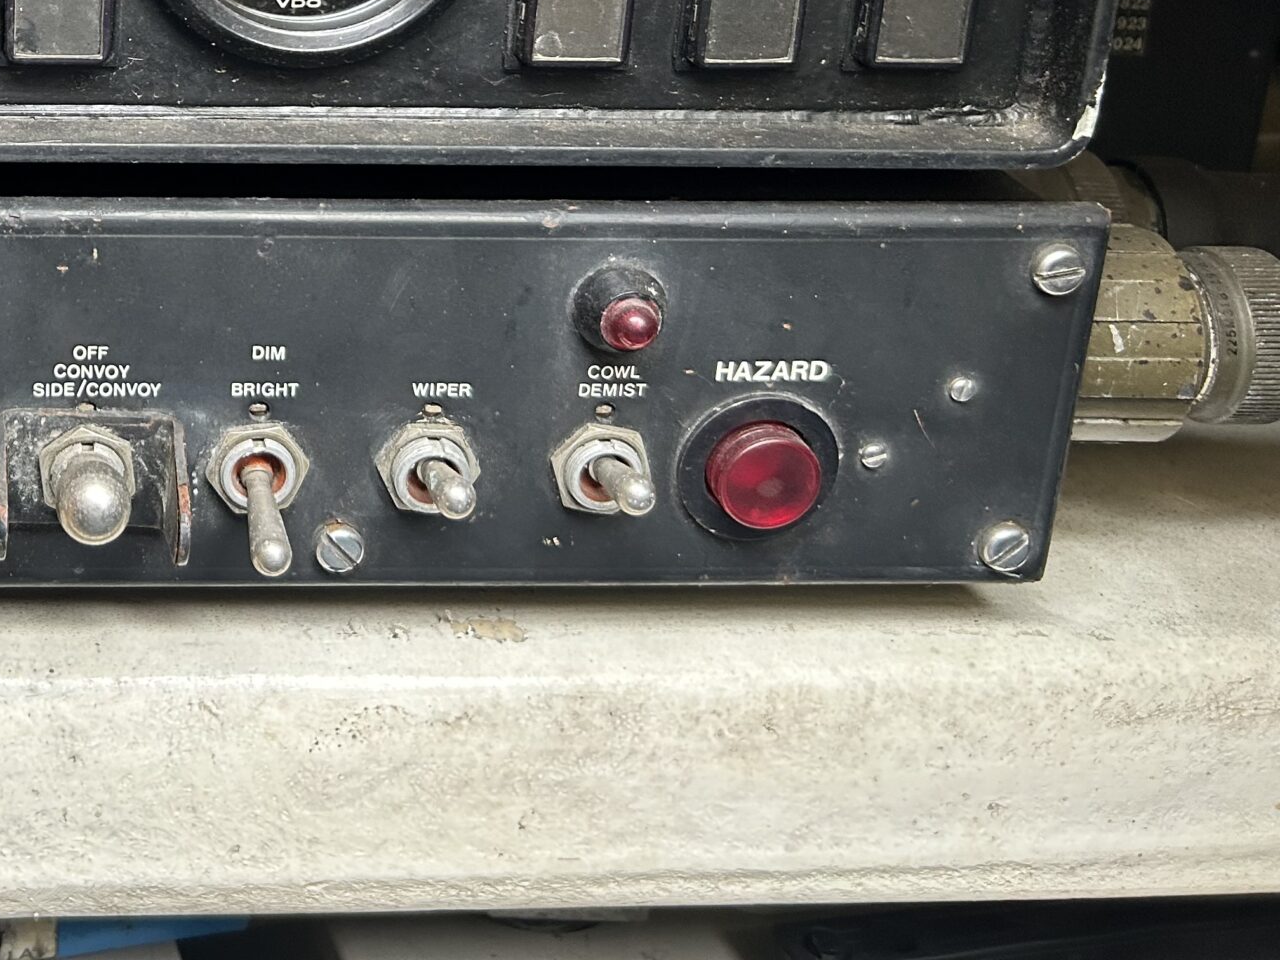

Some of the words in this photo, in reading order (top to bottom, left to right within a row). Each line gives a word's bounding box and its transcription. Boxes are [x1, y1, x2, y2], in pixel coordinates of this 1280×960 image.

[72, 345, 109, 361] OFF
[251, 344, 286, 361] DIM
[53, 363, 130, 380] CONVOY
[587, 364, 641, 380] COWL
[715, 360, 829, 383] HAZARD
[32, 381, 162, 398] SIDE/CONVOY
[230, 381, 299, 398] BRIGHT
[412, 382, 472, 398] WIPER
[578, 382, 647, 398] DEMIST
